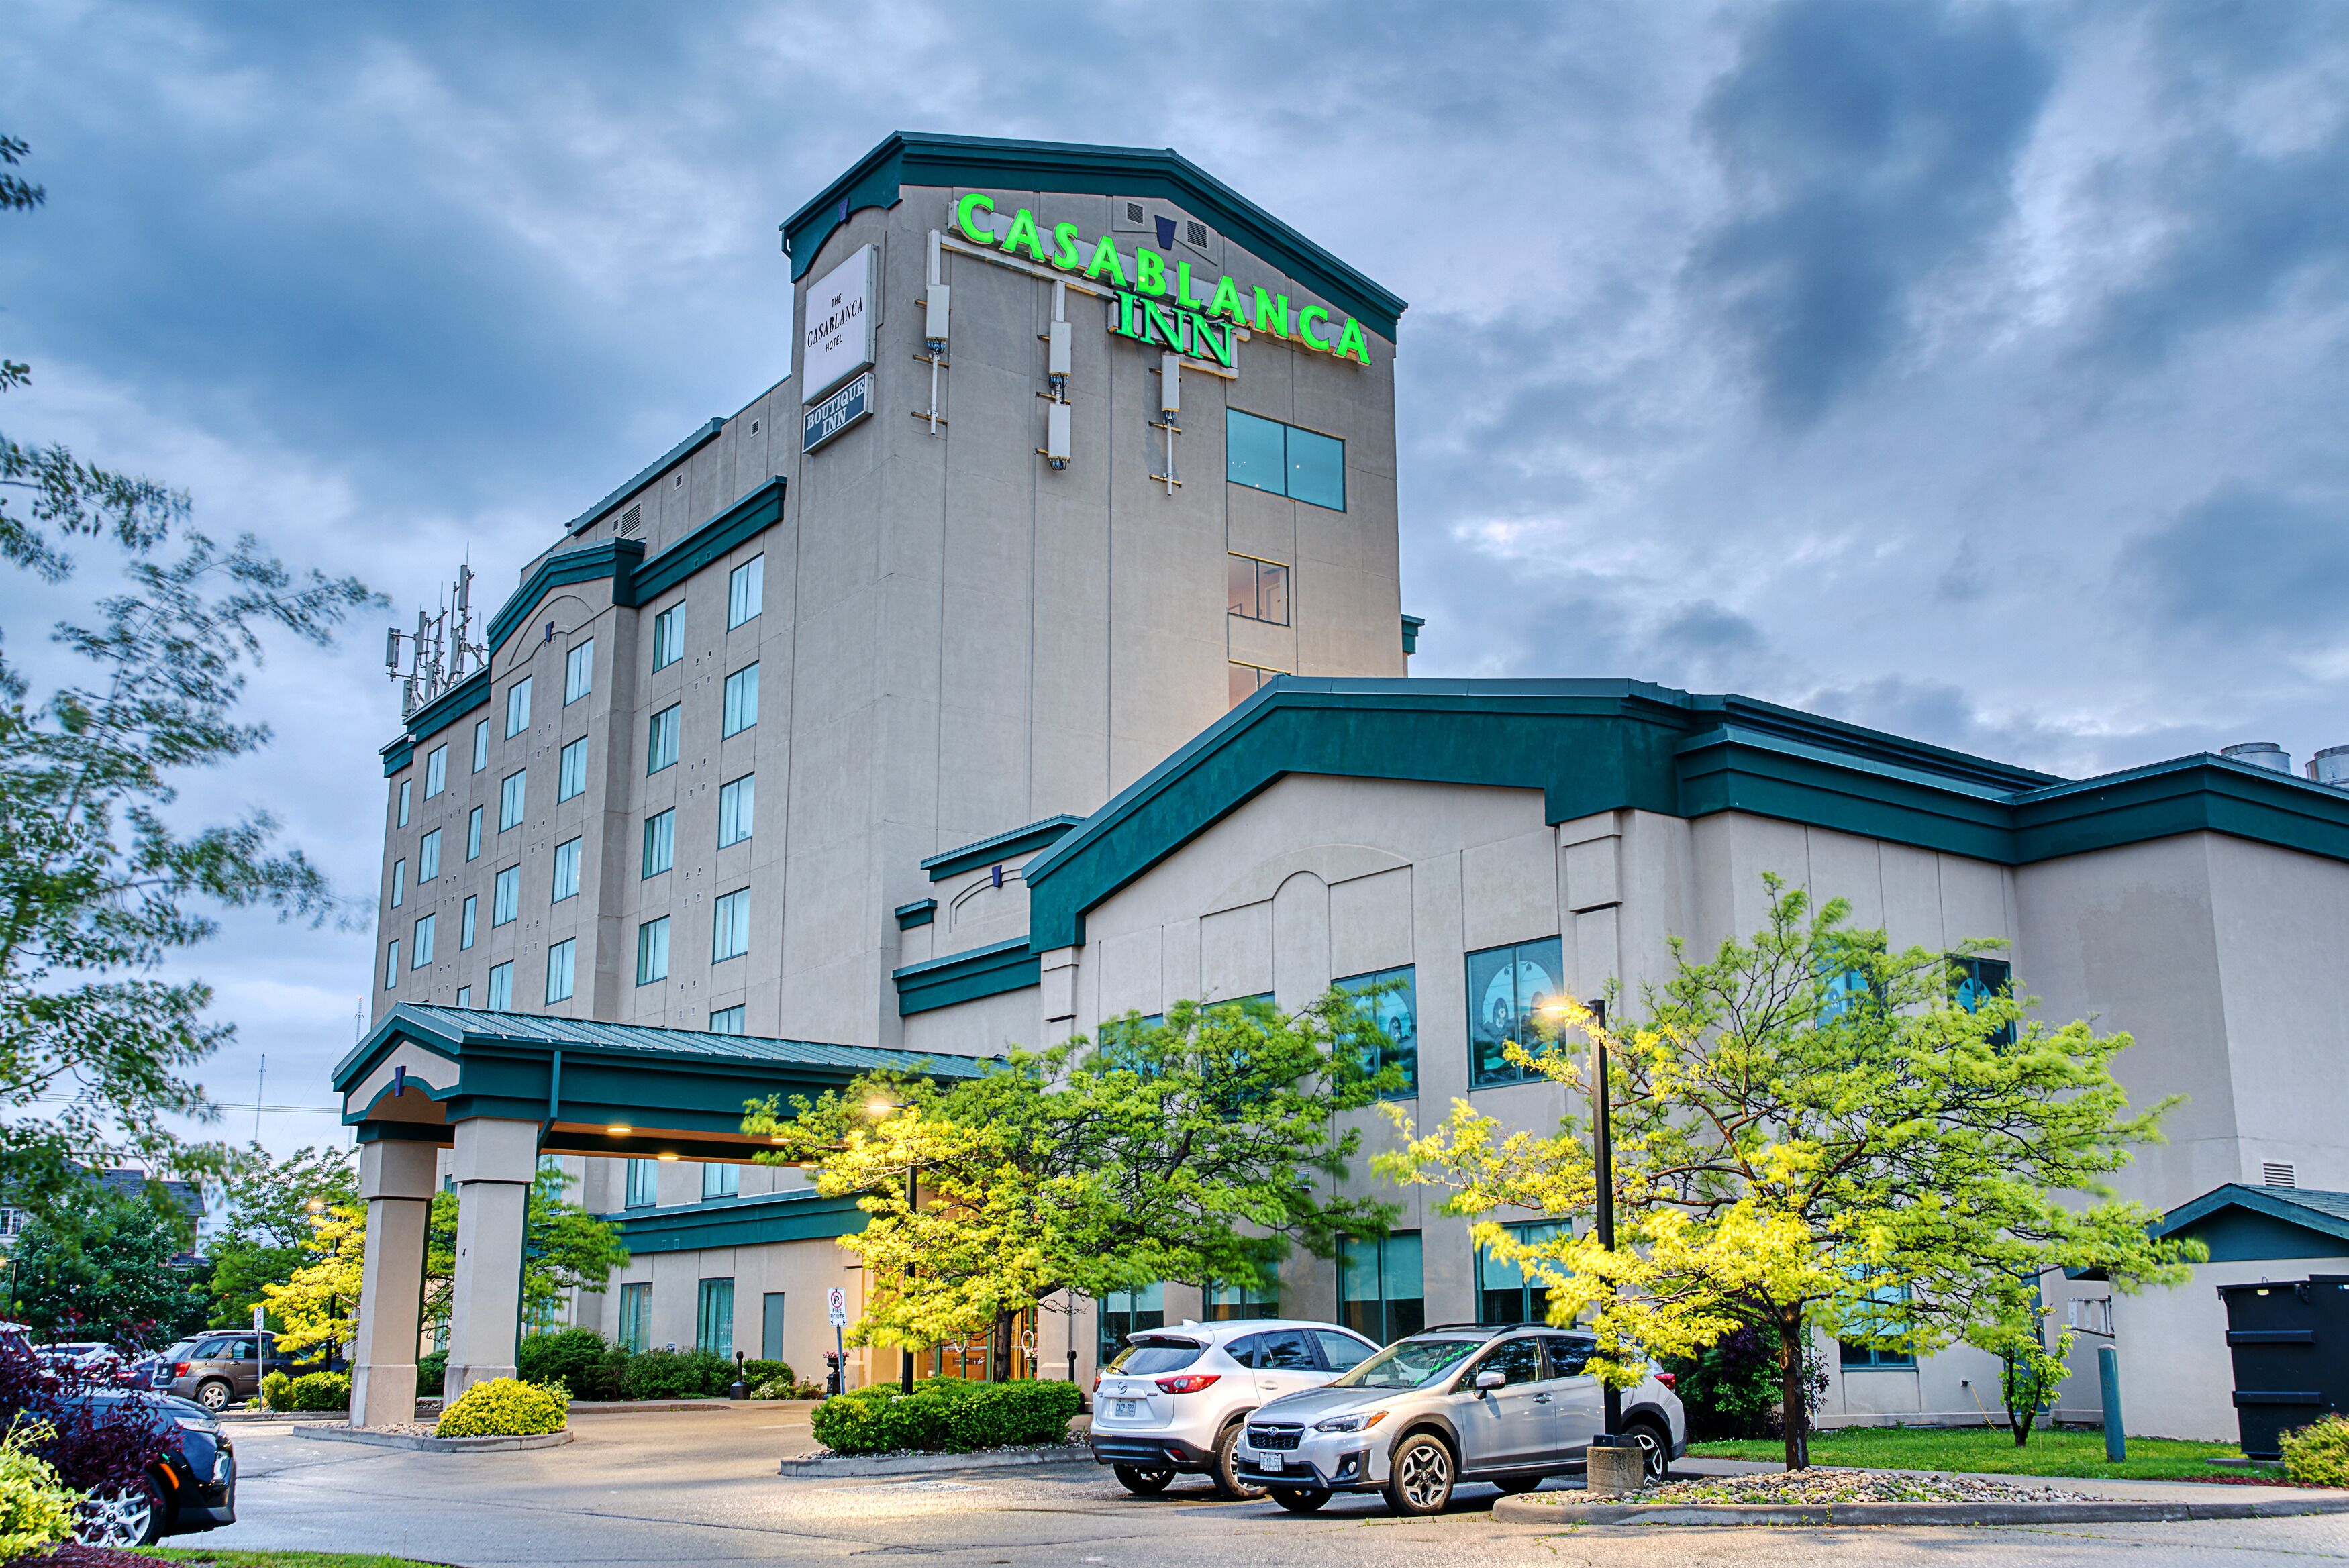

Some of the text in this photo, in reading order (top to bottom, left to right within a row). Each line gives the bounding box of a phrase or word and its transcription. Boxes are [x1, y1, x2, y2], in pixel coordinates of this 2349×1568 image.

[831, 293, 842, 308] THE
[956, 193, 1372, 366] CASABLANCA
[807, 296, 863, 348] CASABLANCA
[825, 334, 842, 353] HOTEL
[1113, 289, 1236, 368] INN
[806, 378, 865, 431] BOUTIQUE
[821, 406, 847, 438] INN
